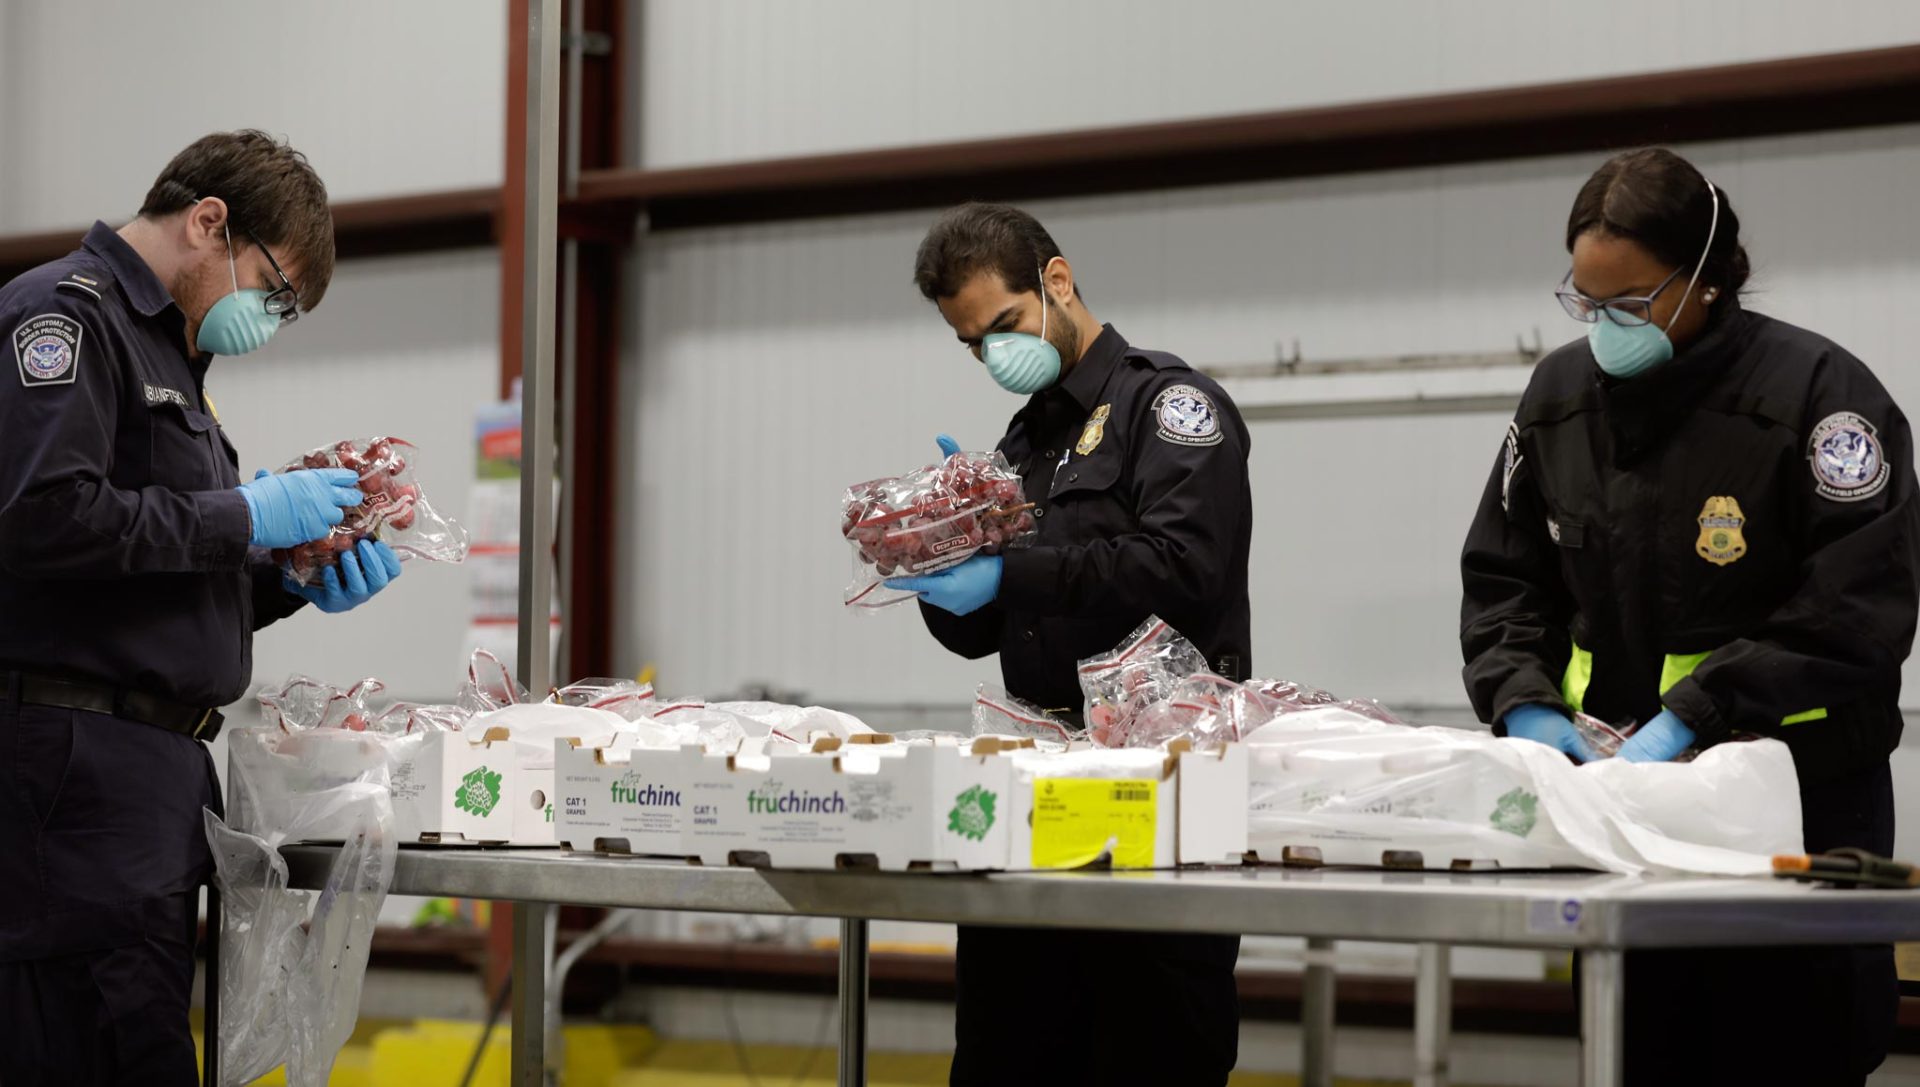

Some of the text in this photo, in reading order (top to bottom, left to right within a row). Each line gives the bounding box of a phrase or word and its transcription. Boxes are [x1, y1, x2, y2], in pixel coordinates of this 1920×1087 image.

[33, 319, 64, 329] CUSTOMS
[18, 329, 40, 349] BORDER
[40, 327, 76, 344] PROTECTION
[566, 797, 587, 806] CAT 1
[610, 780, 681, 807] fruchinc
[747, 789, 845, 814] fruchinch
[693, 805, 718, 815] CAT 1
